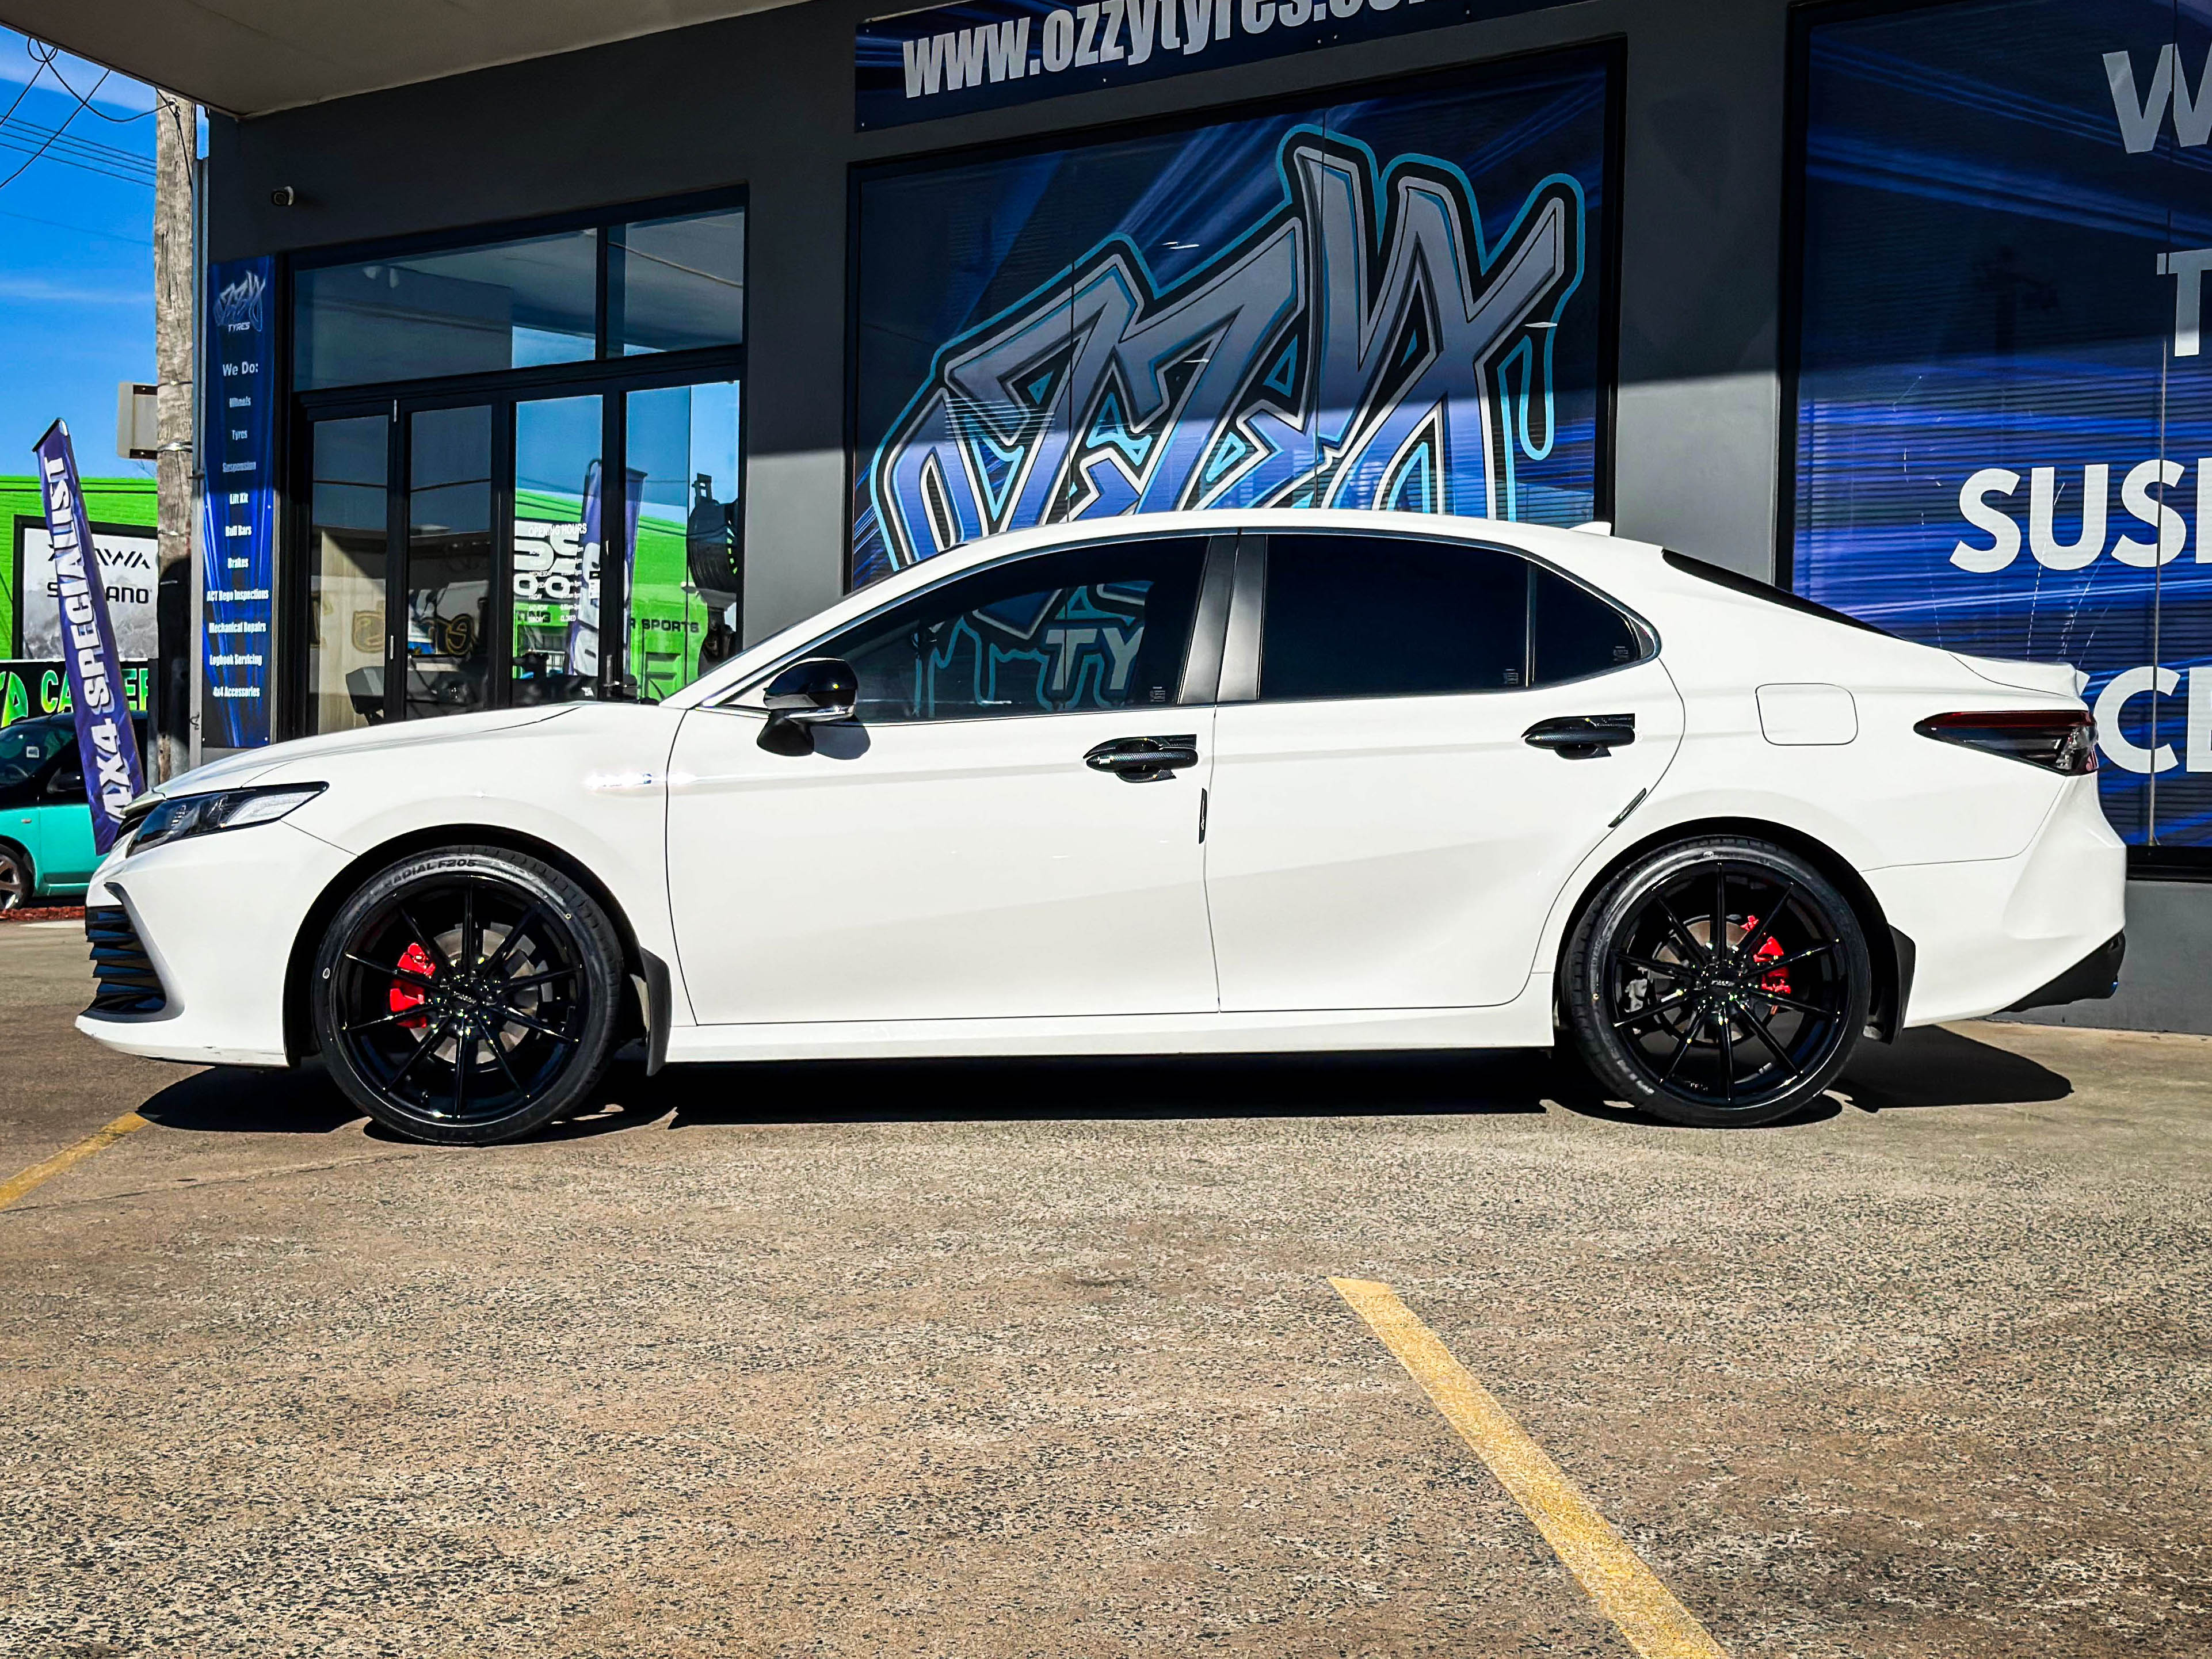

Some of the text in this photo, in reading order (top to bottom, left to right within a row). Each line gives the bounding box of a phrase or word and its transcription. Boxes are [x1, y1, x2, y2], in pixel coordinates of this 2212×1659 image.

[228, 322, 250, 332] TYRES
[223, 361, 258, 376] We Do:
[232, 430, 247, 440] Tyres
[238, 525, 251, 536] Bars
[529, 523, 587, 536] OPENING HOURS
[228, 557, 249, 569] Brakes
[44, 457, 110, 707] SPECIALIST
[219, 590, 234, 602] Rego
[234, 589, 269, 601] Inspections
[209, 621, 266, 634] Mechanical Repairs
[642, 619, 699, 633] SPORTS
[209, 654, 262, 666] Logbook Servicing
[224, 686, 260, 697] Accessories
